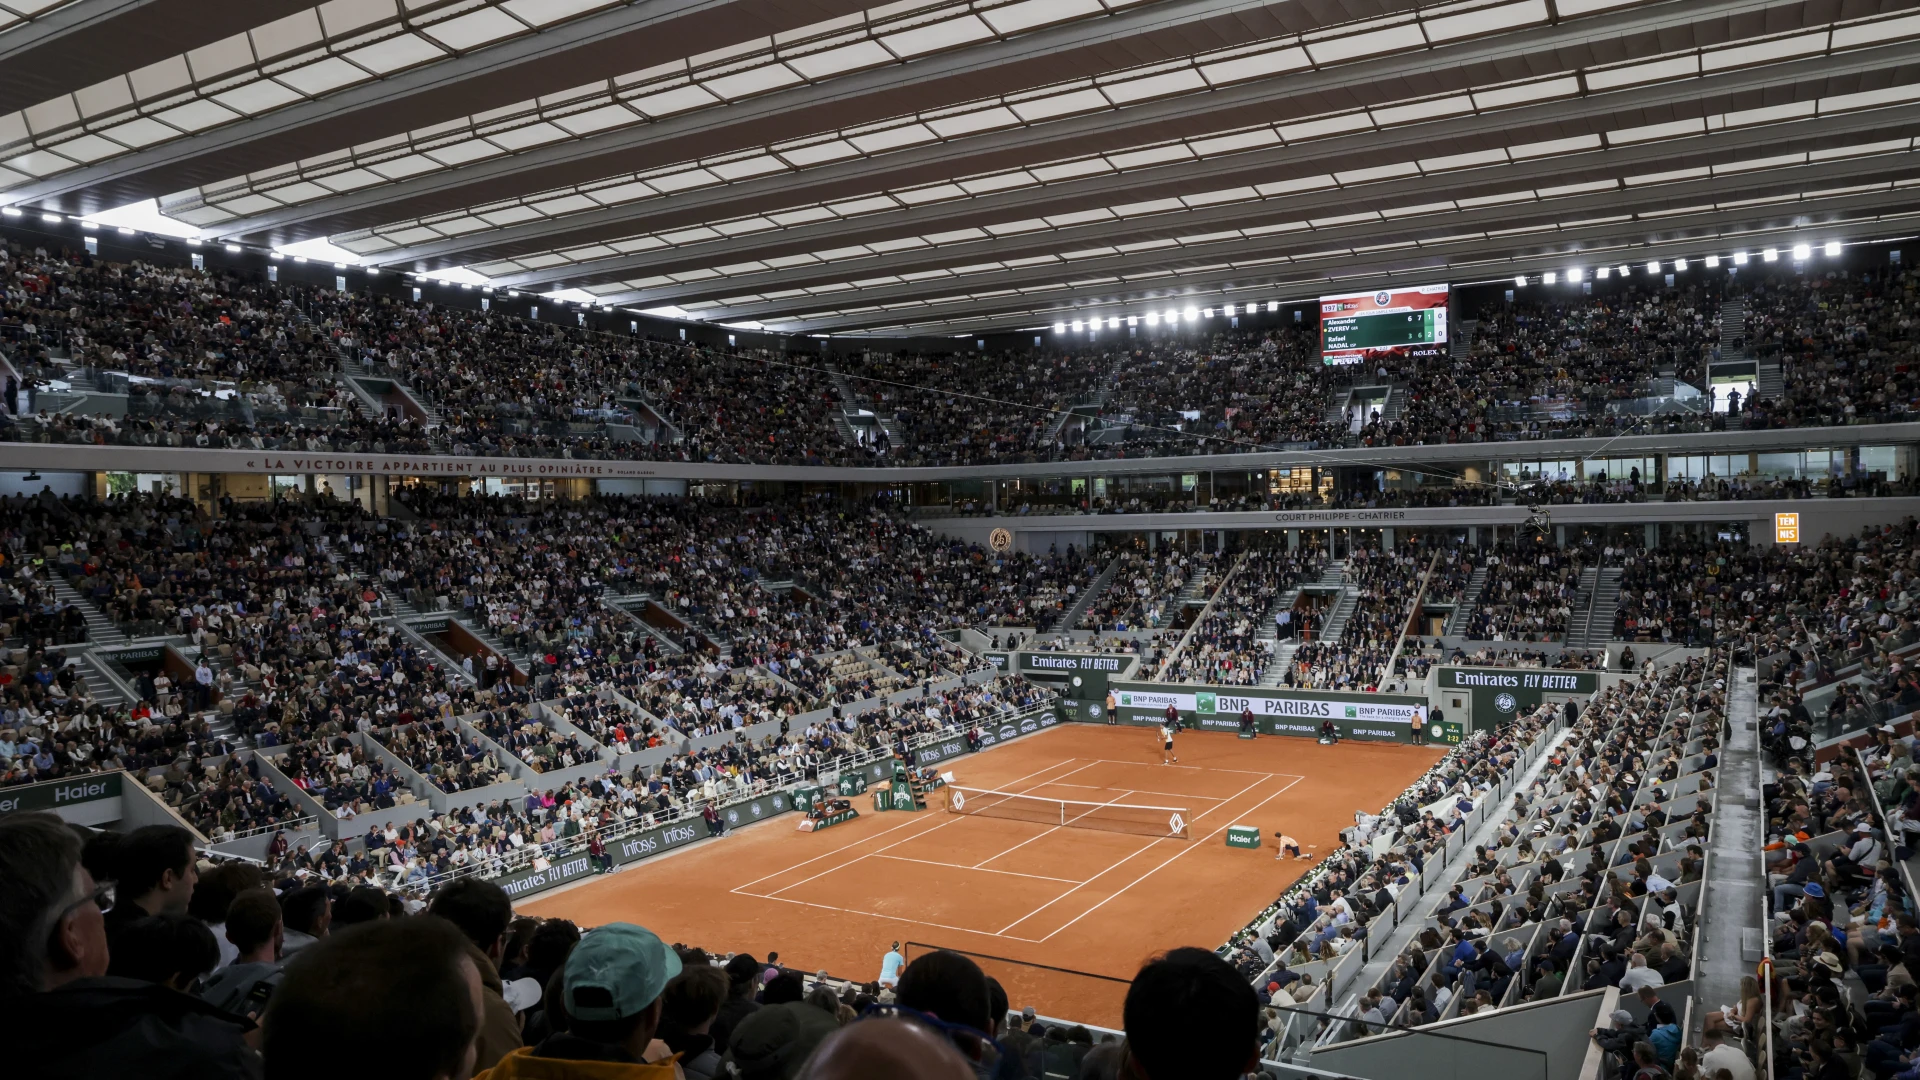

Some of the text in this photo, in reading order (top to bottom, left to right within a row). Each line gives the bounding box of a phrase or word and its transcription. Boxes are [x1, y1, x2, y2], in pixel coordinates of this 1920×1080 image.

[265, 458, 285, 469] LA
[294, 460, 374, 470] VICTOIRE
[383, 462, 472, 472] APPARTIENT
[480, 464, 496, 472] AU
[503, 464, 532, 473] PLUS
[539, 463, 602, 474] OPINIÂTRE
[1276, 514, 1306, 522] COURT
[1779, 517, 1794, 525] TEN
[1780, 530, 1794, 538] NIS
[120, 650, 159, 660] PARIBAS
[1032, 656, 1119, 670] Emirates FLY BETTER
[1455, 672, 1577, 689] Emirates FLY BETTER
[1220, 698, 1330, 716] BNP PARIBAS
[1377, 708, 1411, 717] PARIBAS
[55, 782, 107, 802] Haier
[662, 825, 695, 844] Infosys
[1230, 834, 1251, 843] Haier
[622, 837, 657, 857] Infosys
[501, 858, 588, 896] mirates FLY BETTER
